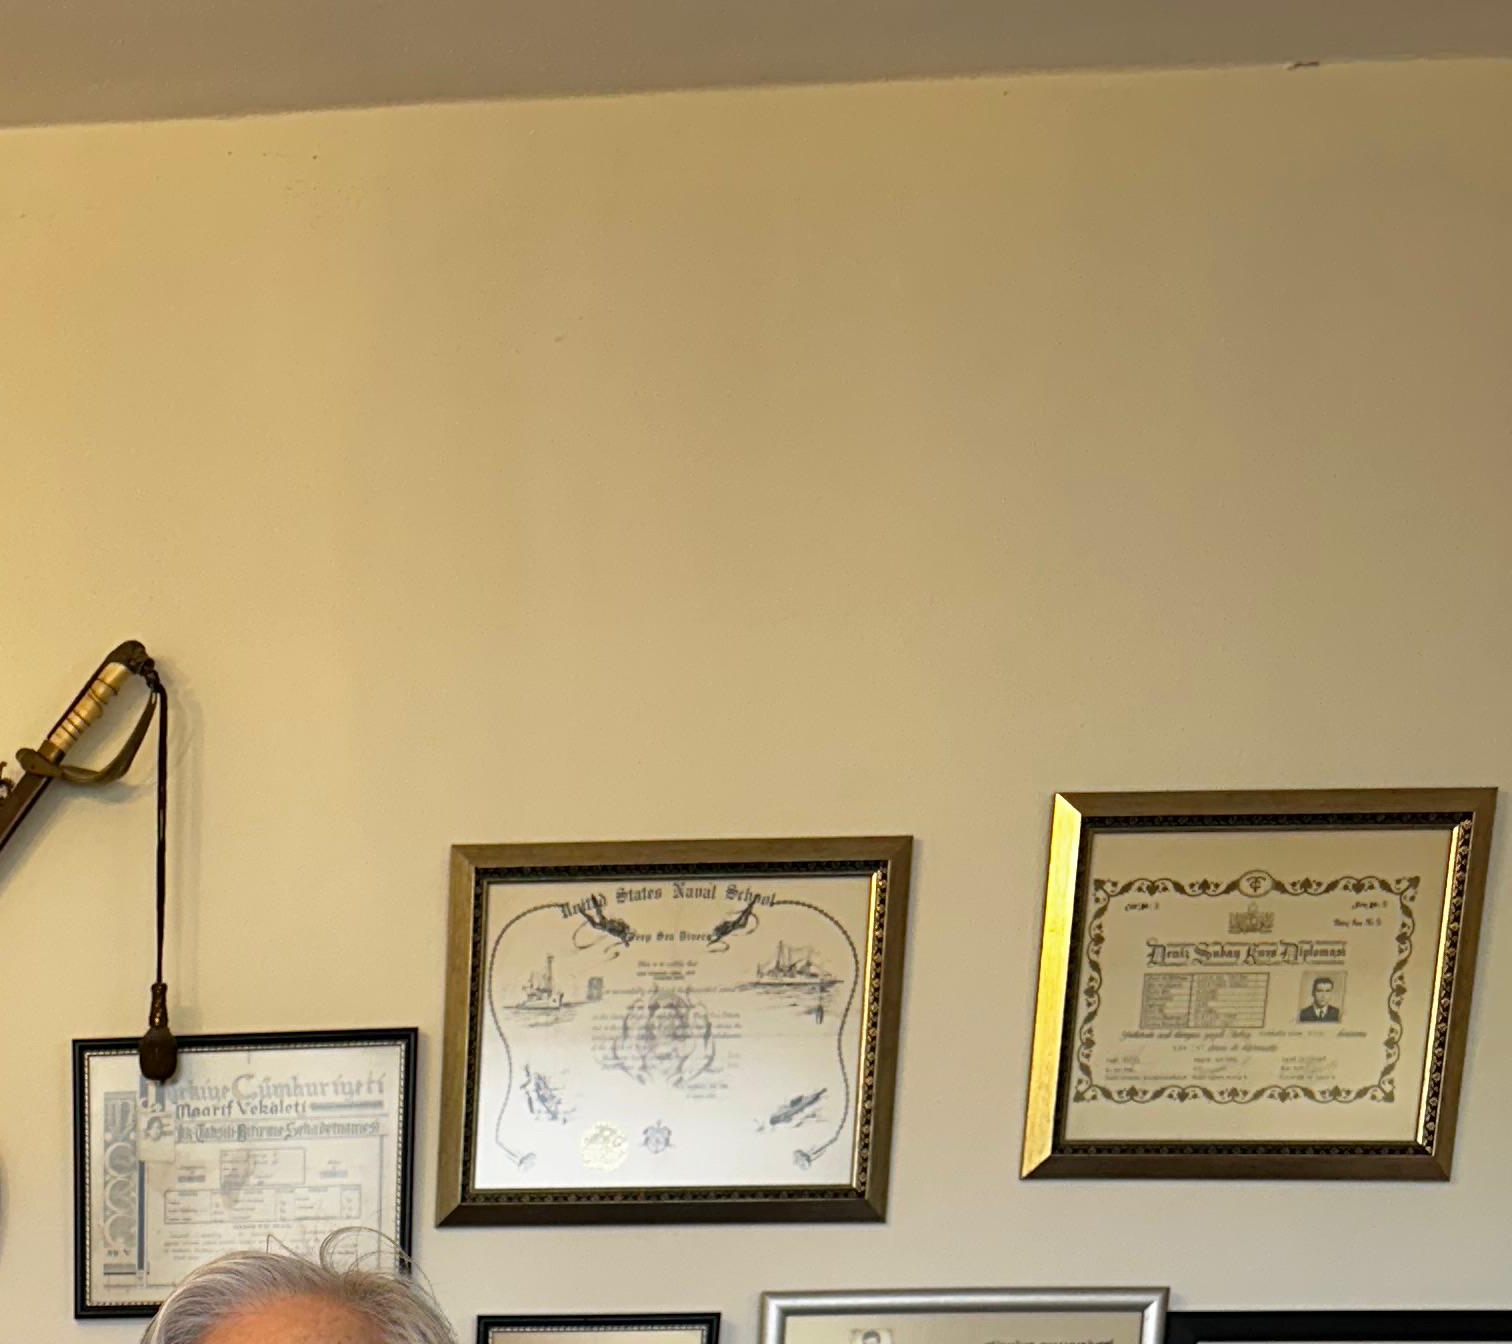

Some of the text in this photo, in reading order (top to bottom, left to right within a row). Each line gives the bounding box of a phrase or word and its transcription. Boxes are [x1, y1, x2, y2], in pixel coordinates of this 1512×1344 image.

[560, 893, 608, 918] Unitd
[615, 887, 662, 904] States
[672, 881, 716, 900] Naval
[656, 932, 674, 941] Sea
